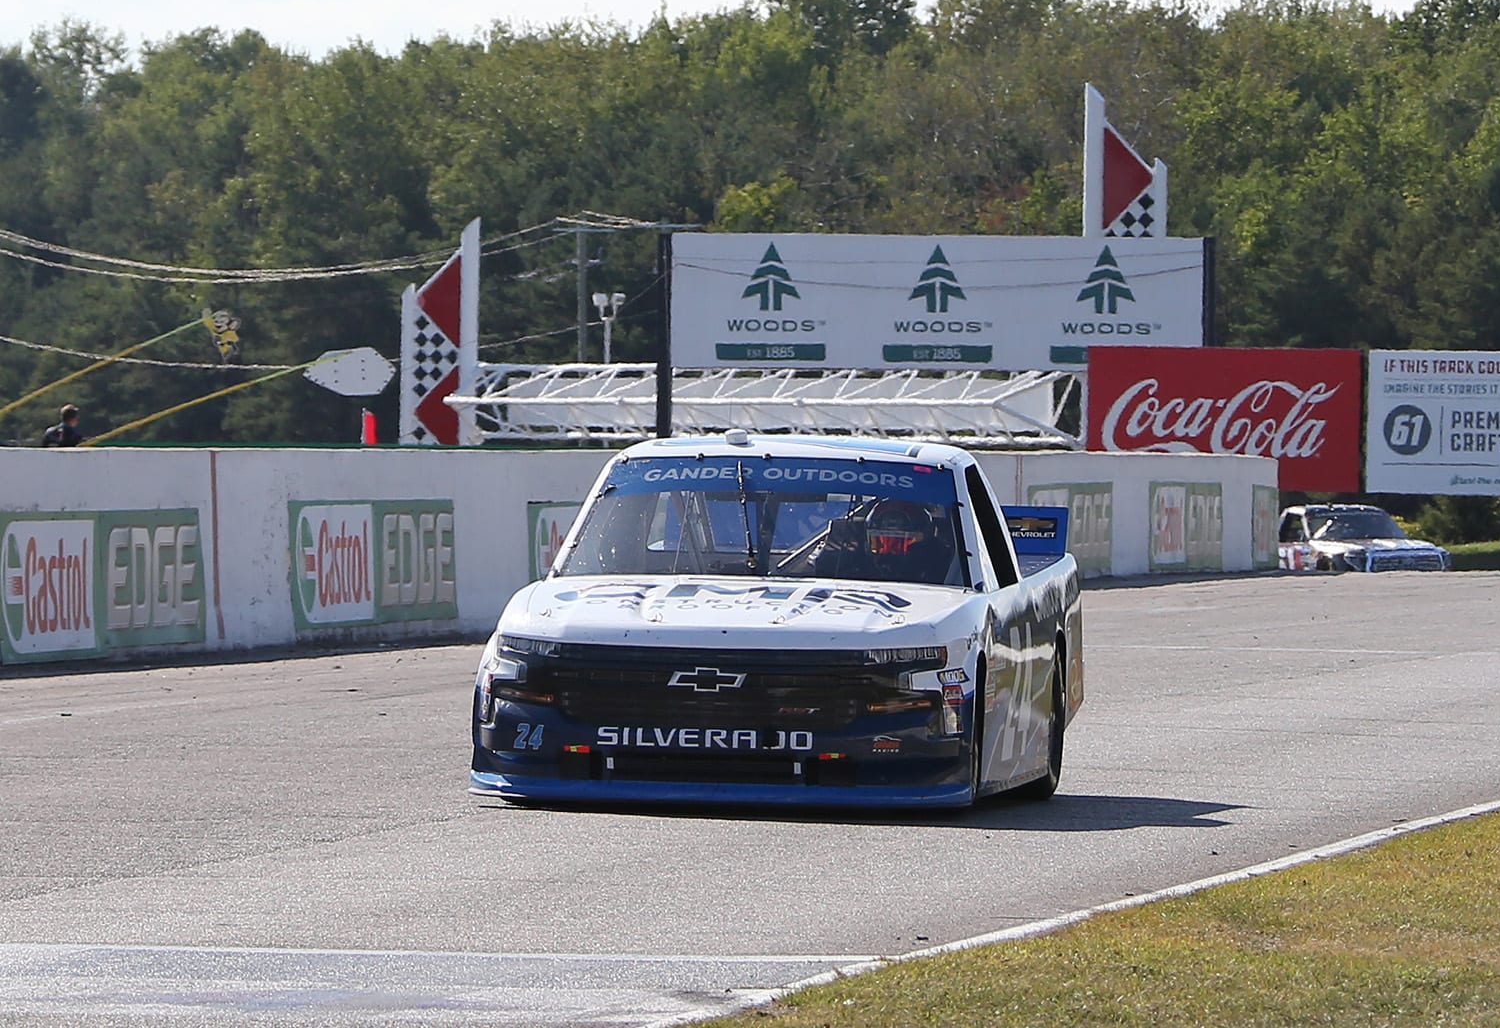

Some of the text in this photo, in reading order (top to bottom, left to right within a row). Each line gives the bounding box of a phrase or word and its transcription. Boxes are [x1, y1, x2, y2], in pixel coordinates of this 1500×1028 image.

[727, 319, 815, 332] WOODS
[894, 321, 982, 333] WOODS
[1062, 322, 1151, 335] WOODS
[765, 346, 796, 358] 1885
[1384, 359, 1397, 373] IF
[1400, 359, 1428, 374] THIS
[1433, 360, 1475, 375] TRACK
[1390, 414, 1425, 447] 61
[763, 466, 914, 489] OUTDOORS
[317, 519, 371, 606] Castrol
[382, 512, 455, 607] EDGE
[25, 524, 198, 635] Castrol EDGE
[513, 723, 545, 750] 24
